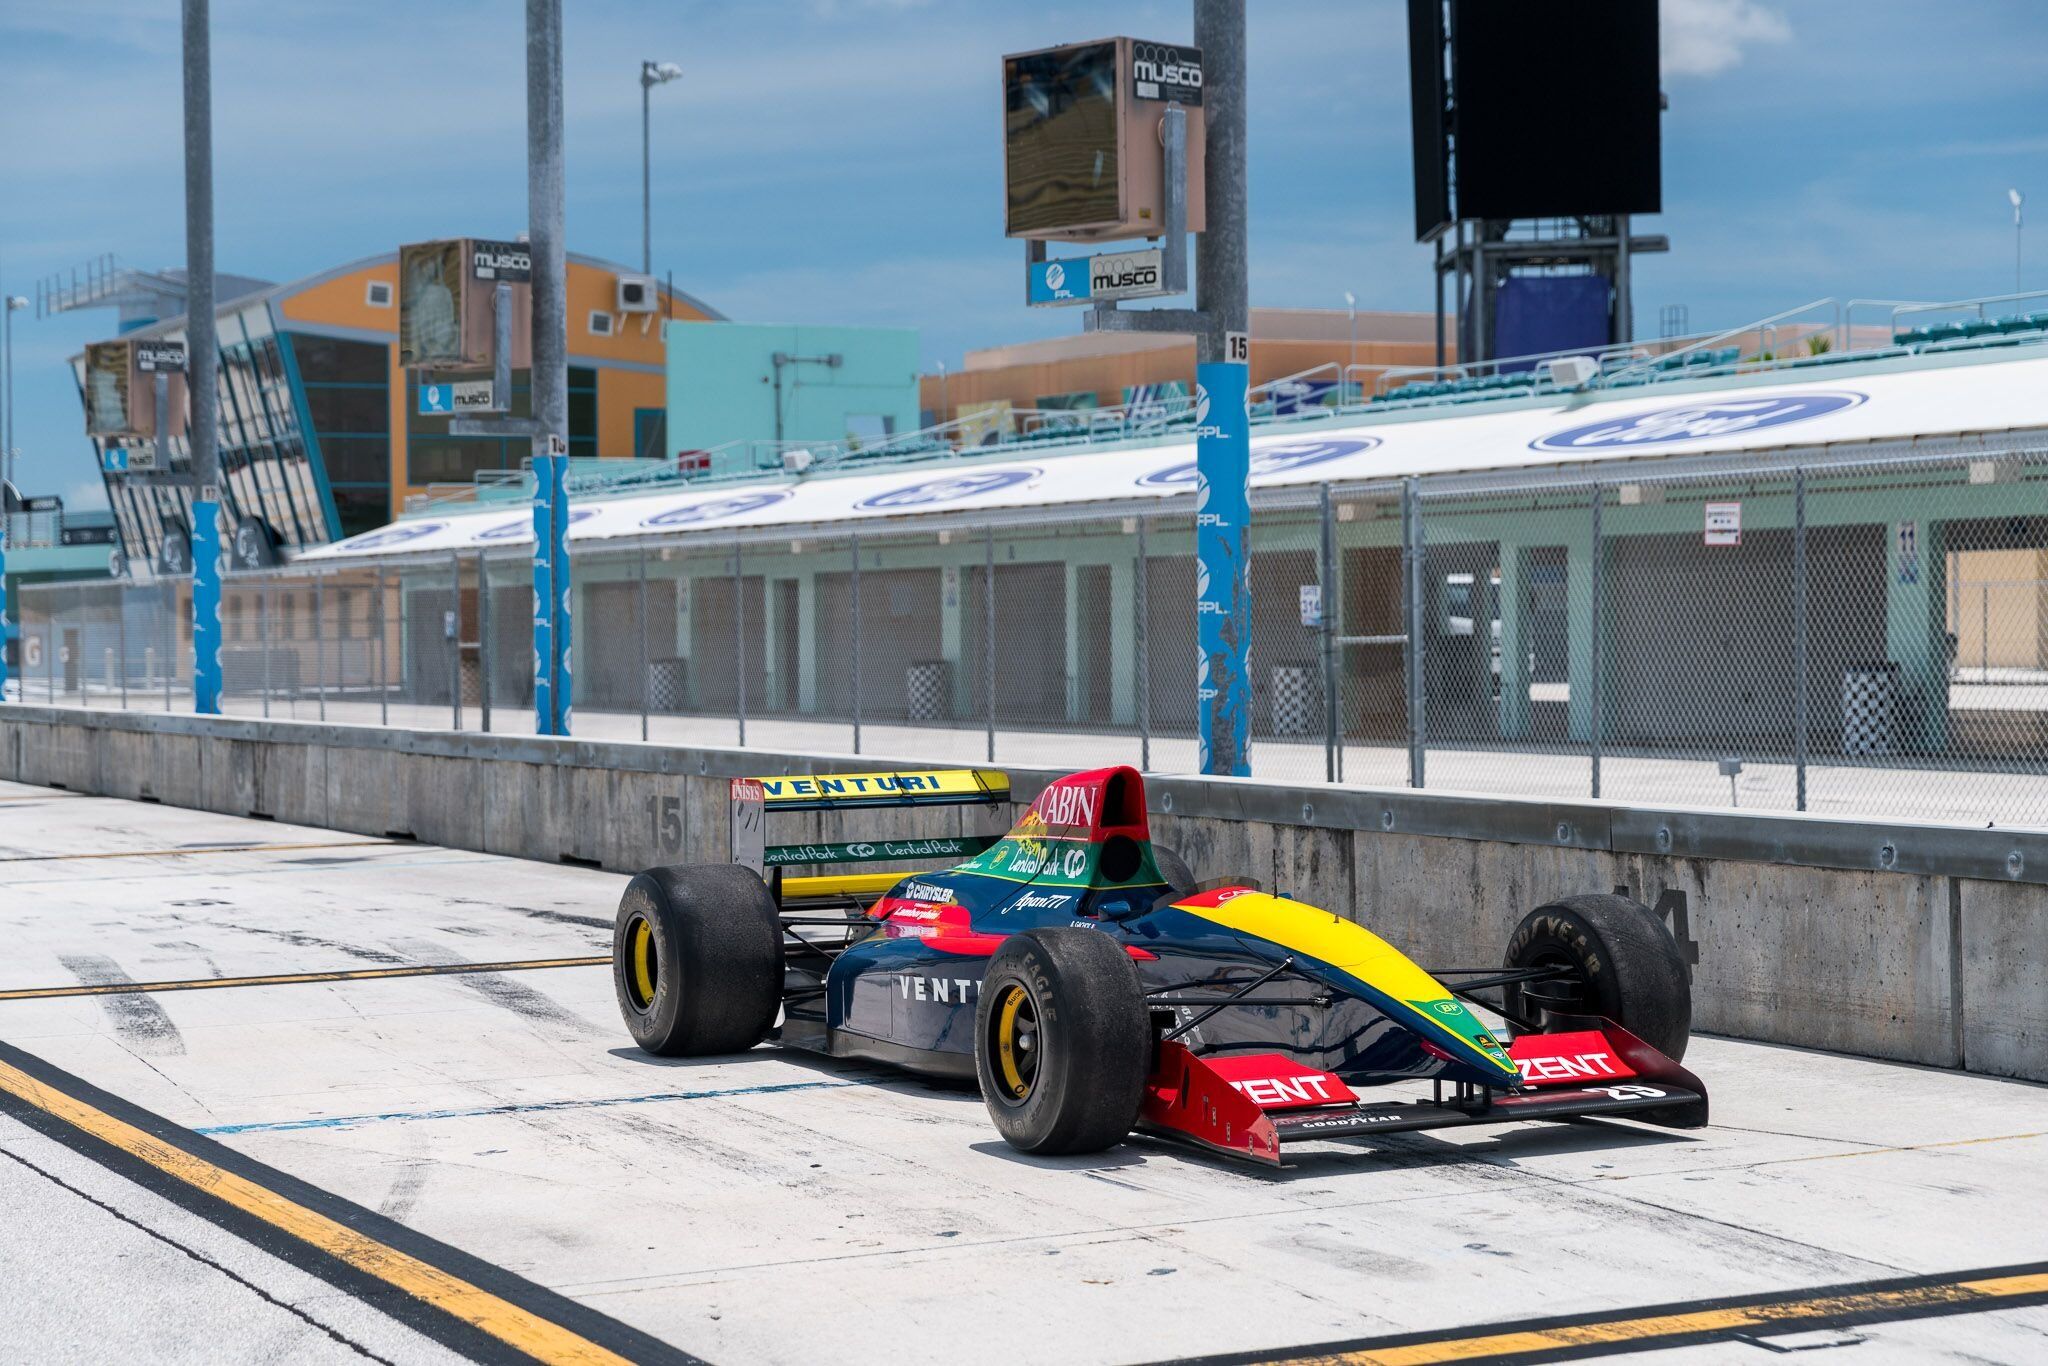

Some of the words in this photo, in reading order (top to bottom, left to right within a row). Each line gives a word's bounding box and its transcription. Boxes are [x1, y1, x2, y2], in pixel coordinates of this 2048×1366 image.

[1229, 336, 1247, 360] 15
[732, 784, 760, 800] UNISYS
[763, 775, 941, 796] VENTURI
[1039, 784, 1097, 827] CABIN
[646, 795, 683, 855] 15
[914, 885, 954, 903] CHRYSLER
[900, 975, 983, 1004] VENT
[1514, 1053, 1616, 1081] ZENT
[1582, 1085, 1667, 1101] 29
[1302, 1115, 1402, 1129] GOODYEAR
